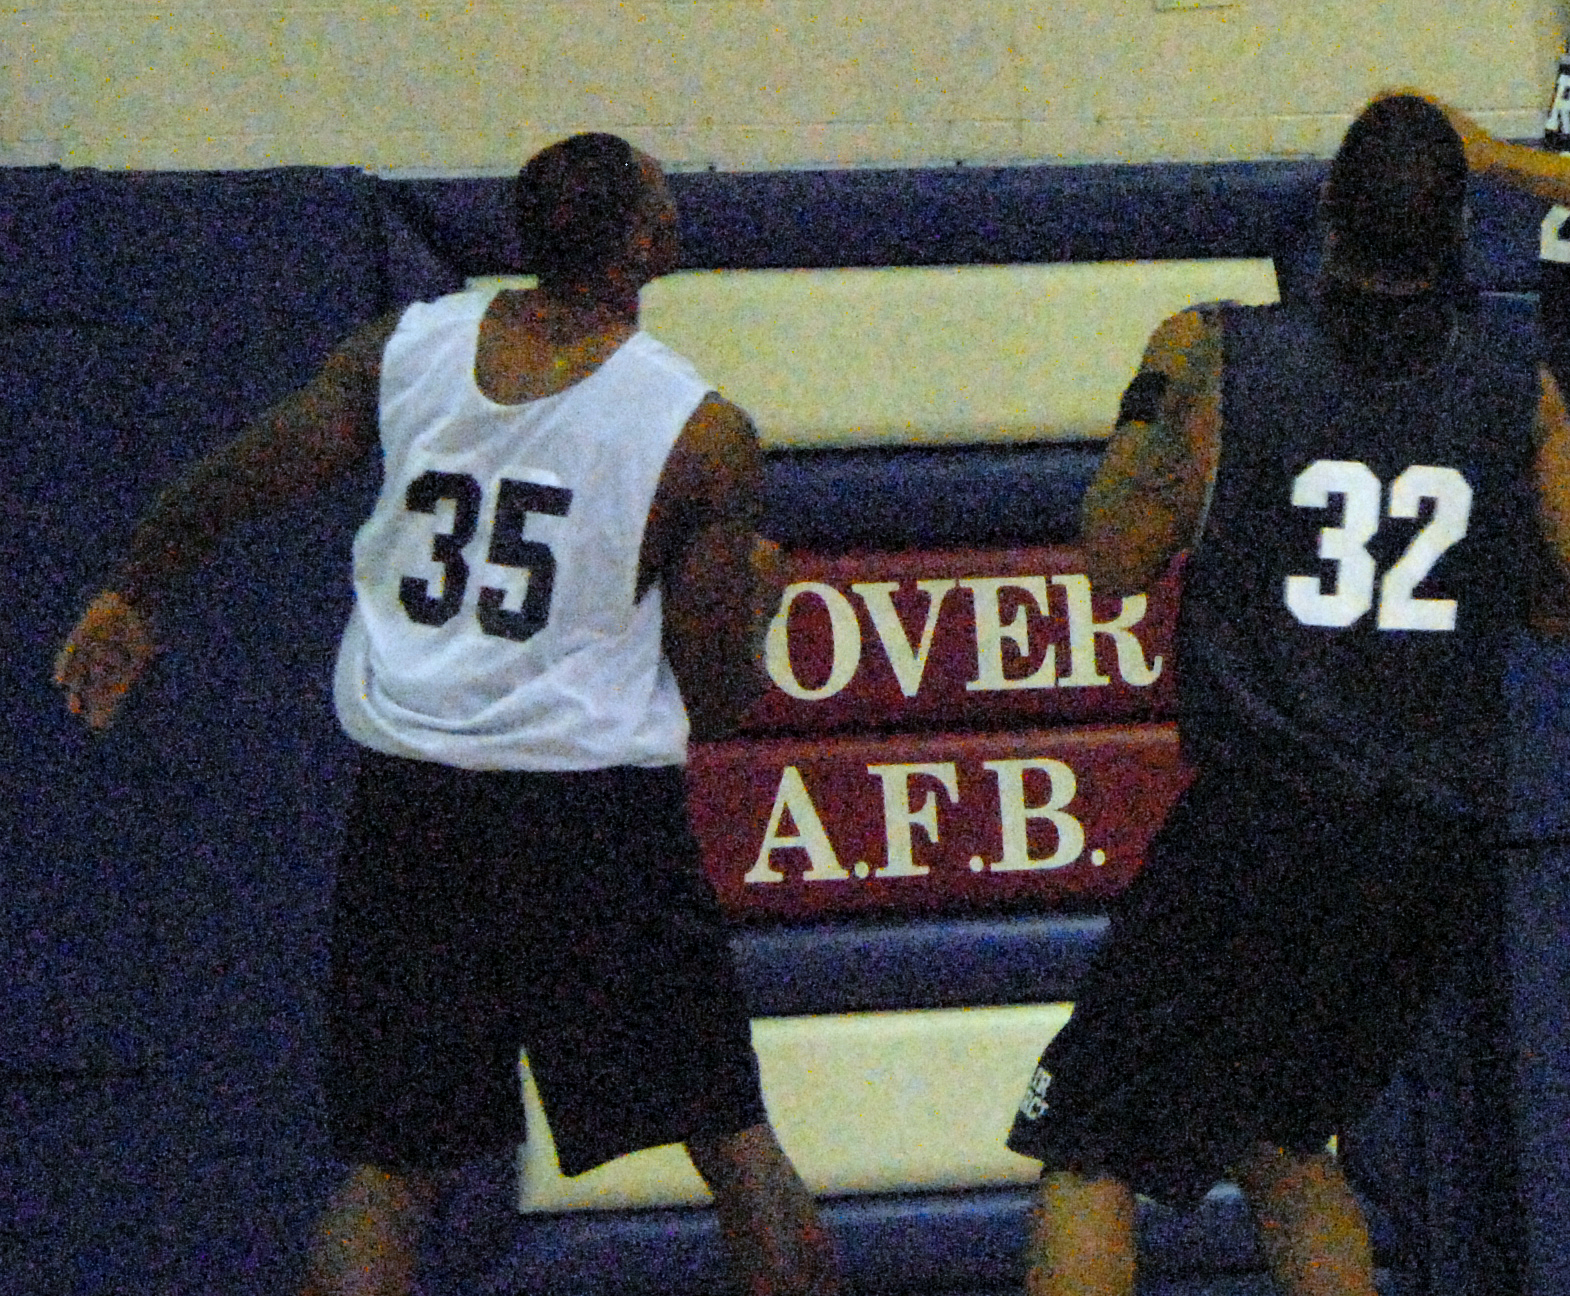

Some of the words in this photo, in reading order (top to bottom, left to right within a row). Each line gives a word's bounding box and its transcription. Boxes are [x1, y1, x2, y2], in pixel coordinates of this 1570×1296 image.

[398, 469, 573, 643] 35
[1284, 459, 1474, 632] 32
[743, 757, 1107, 884] A.F.B.
